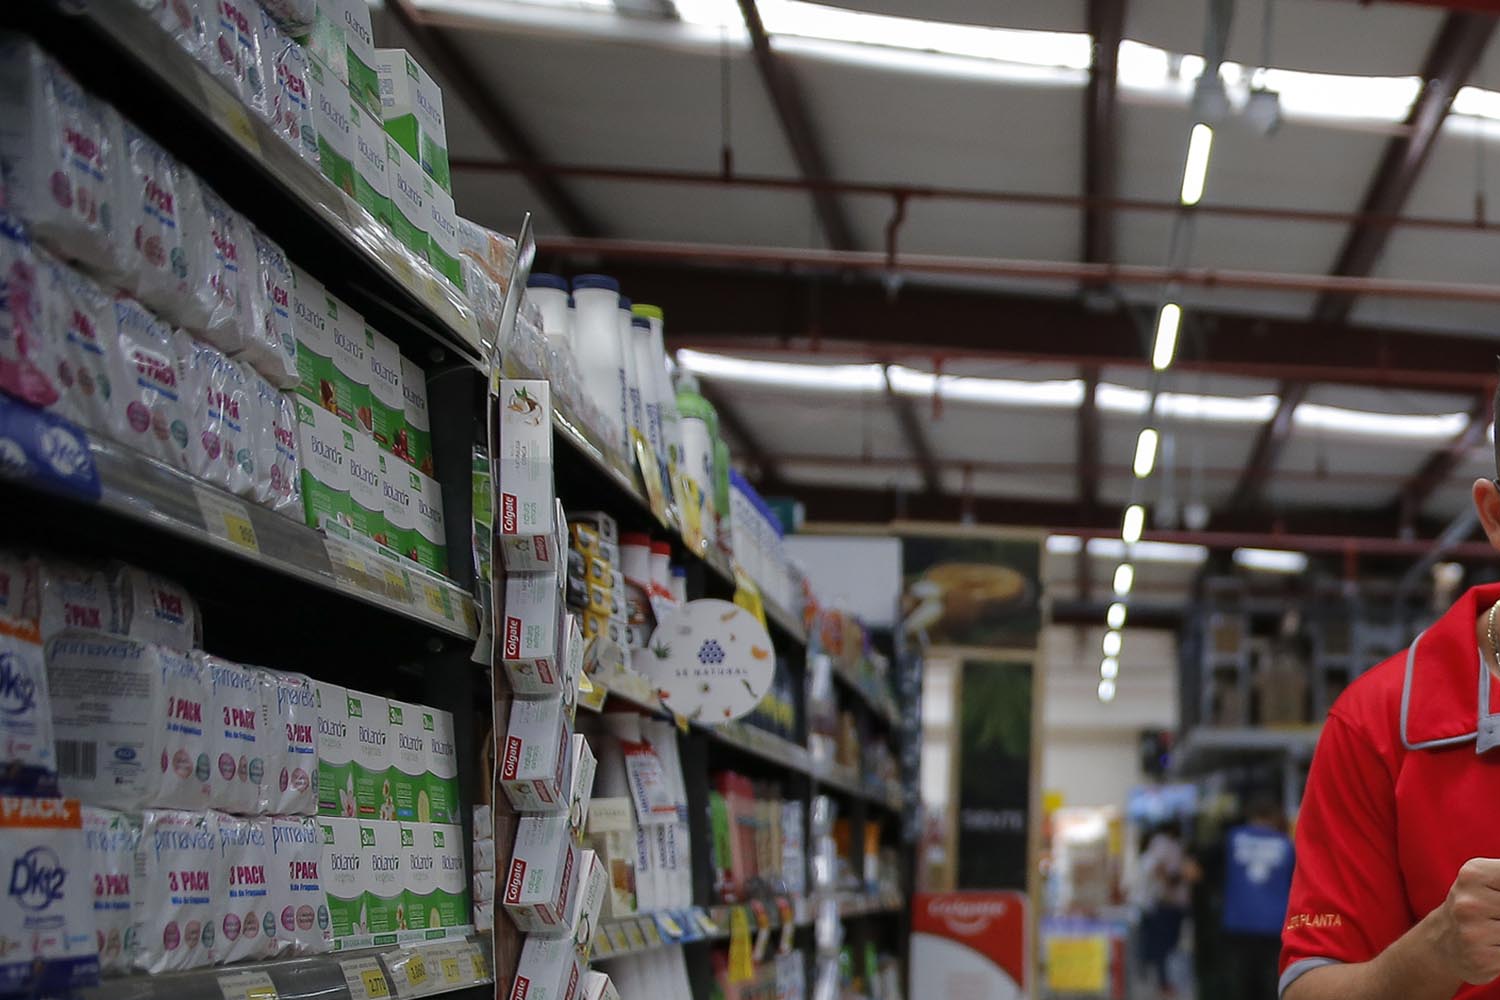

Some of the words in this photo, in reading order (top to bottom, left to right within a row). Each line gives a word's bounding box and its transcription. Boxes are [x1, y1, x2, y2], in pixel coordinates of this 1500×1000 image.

[503, 495, 514, 532] Colgate
[506, 619, 519, 656] Colgate
[504, 739, 519, 777] Colgate
[229, 866, 235, 885] 3
[237, 865, 266, 885] PACK
[508, 861, 523, 901] Colgate
